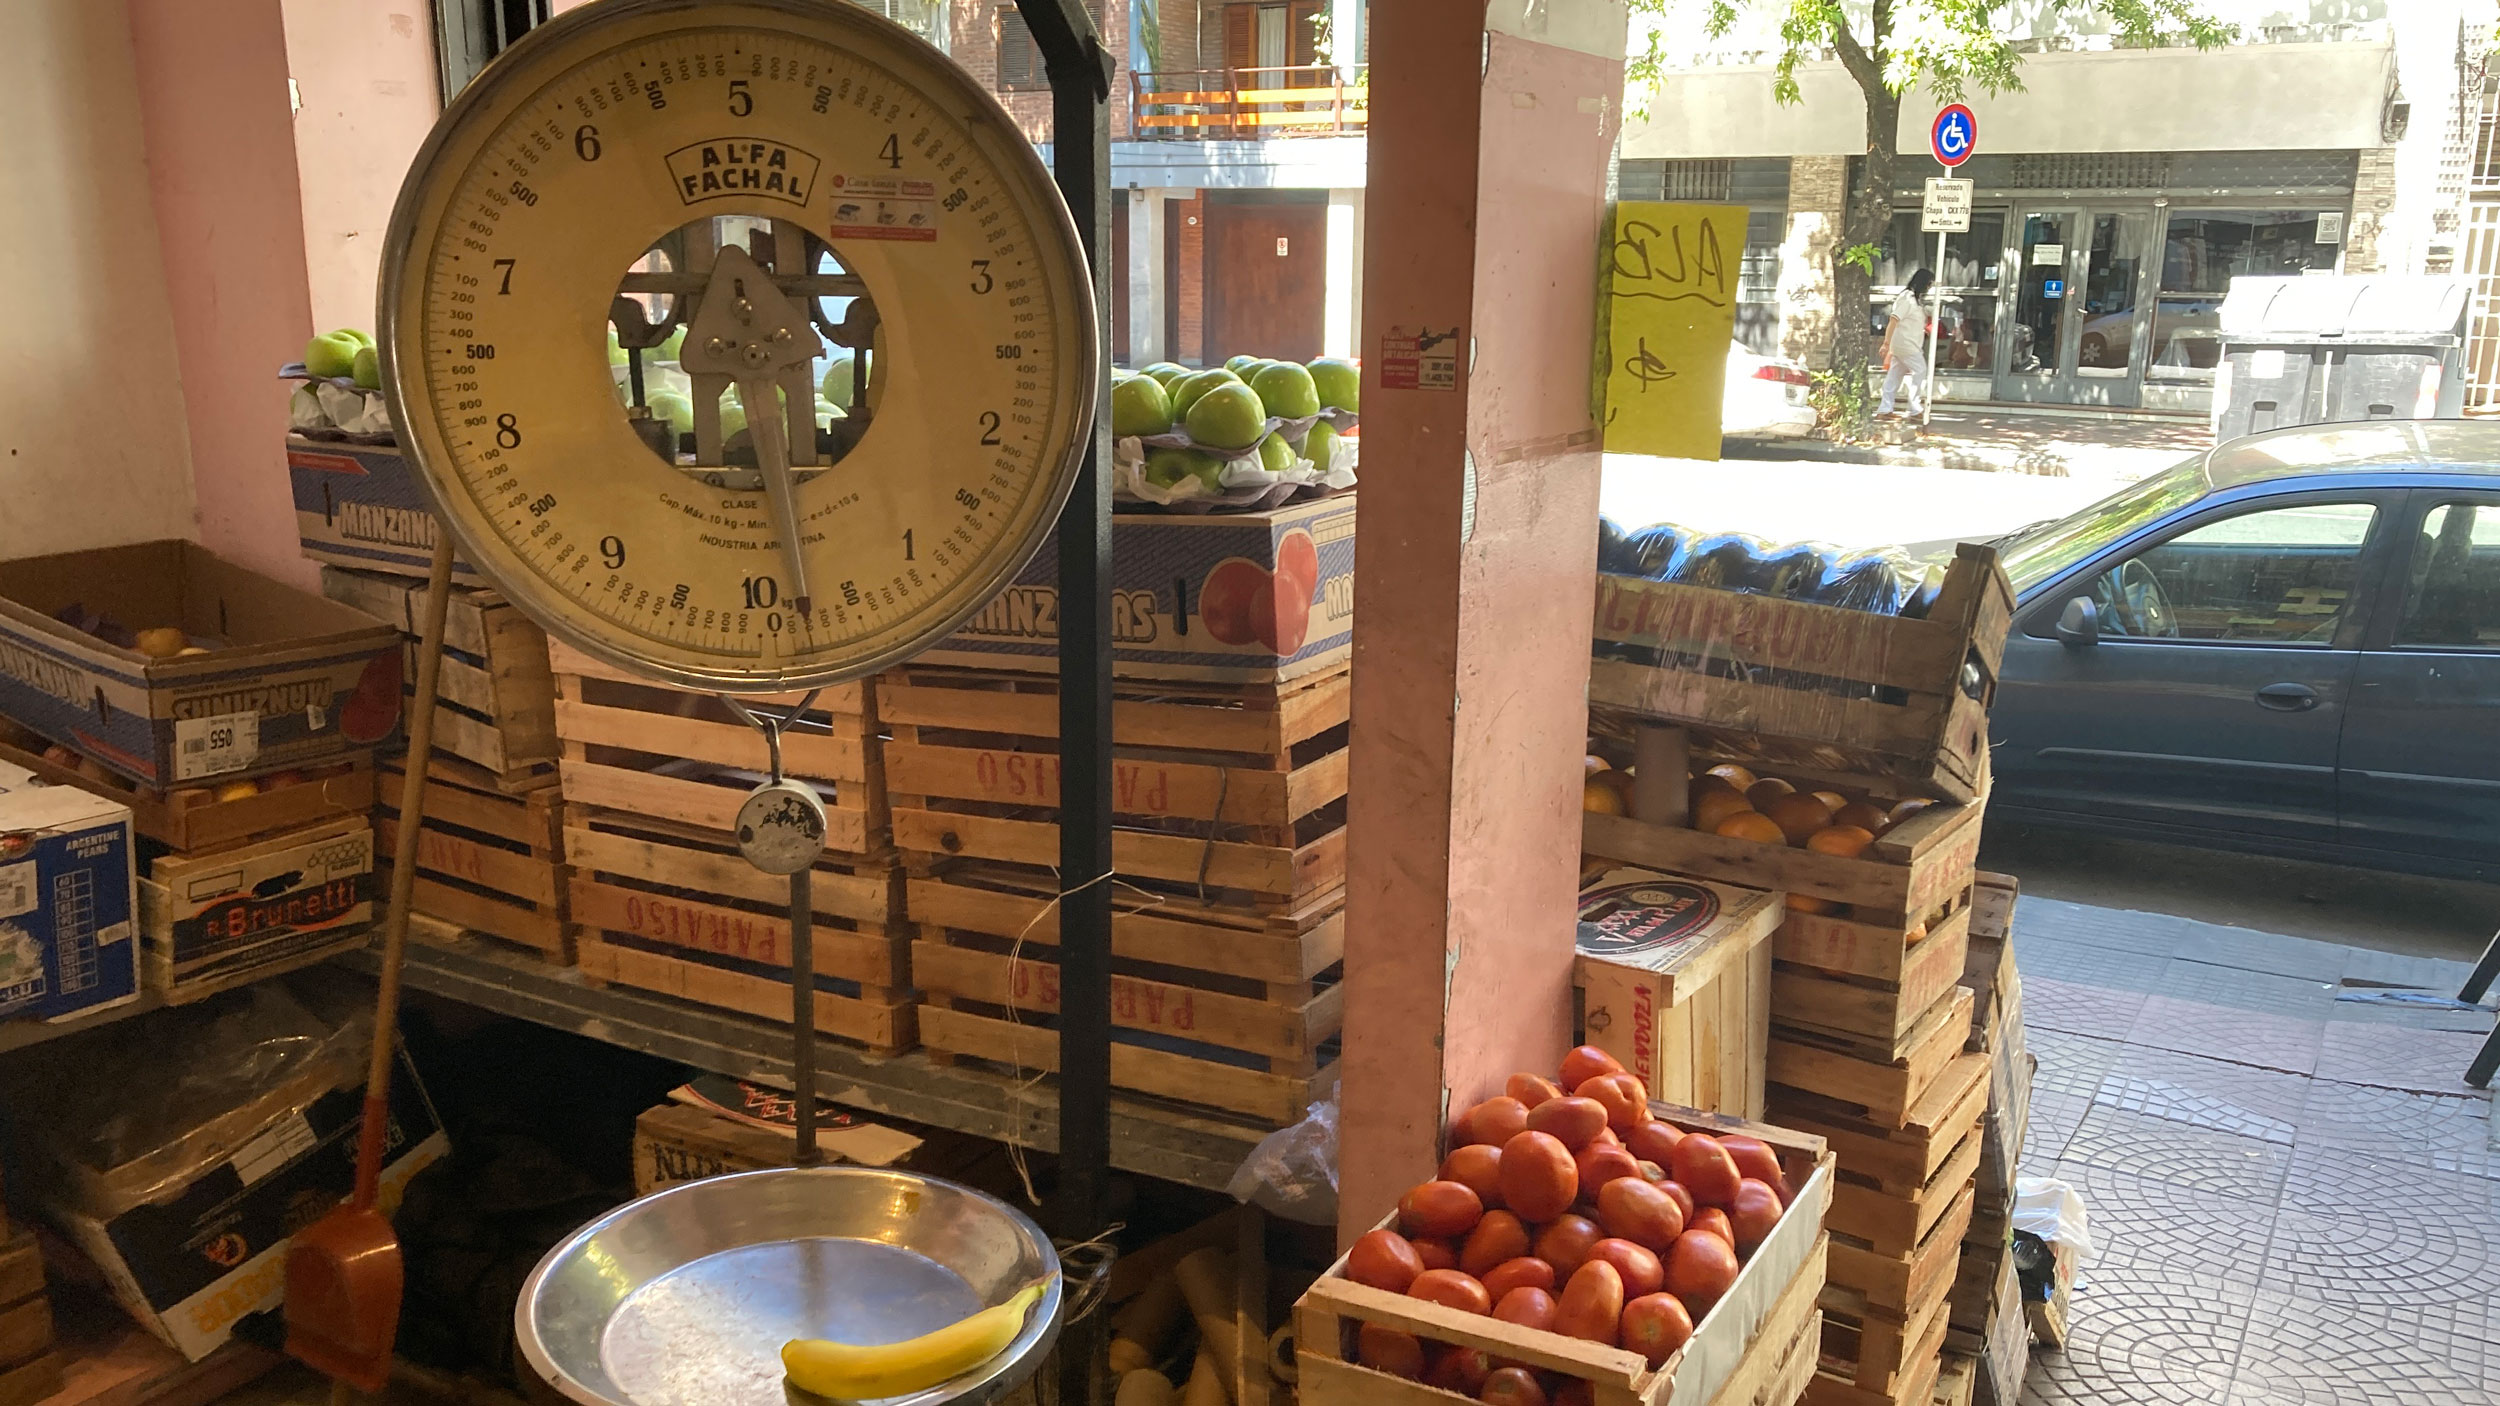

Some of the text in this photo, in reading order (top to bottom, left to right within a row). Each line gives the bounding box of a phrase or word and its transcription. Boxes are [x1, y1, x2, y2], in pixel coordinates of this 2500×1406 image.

[660, 61, 673, 84] 400
[678, 57, 690, 81] 300
[696, 54, 707, 78] 200
[714, 54, 724, 76] 100
[752, 54, 762, 76] 900
[770, 57, 780, 80] 800
[787, 60, 798, 82] 700
[624, 72, 639, 95] 600
[804, 65, 817, 87] 600
[608, 79, 624, 102] 700
[644, 80, 666, 110] 500
[838, 78, 851, 100] 400
[855, 86, 868, 108] 300
[575, 96, 593, 118] 900
[590, 88, 607, 110] 800
[729, 81, 753, 117] 5
[813, 85, 832, 113] 500
[869, 95, 884, 117] 200
[884, 104, 899, 124] 100
[546, 120, 564, 140] 100
[912, 127, 929, 147] 900
[530, 131, 552, 151] 200
[575, 125, 601, 161] 6
[879, 133, 903, 168] 4
[925, 140, 943, 159] 800
[518, 144, 539, 164] 300
[937, 152, 955, 171] 700
[506, 158, 528, 177] 400
[949, 167, 968, 184] 600
[682, 168, 803, 198] FACHAL
[486, 188, 508, 206] 600
[510, 181, 538, 206] 500
[942, 188, 968, 212] 500
[478, 204, 500, 221] 700
[970, 196, 989, 212] 400
[1926, 206, 1942, 215] Chapa
[469, 220, 493, 236] 800
[979, 212, 999, 227] 300
[464, 238, 486, 252] 900
[987, 228, 1006, 243] 200
[994, 244, 1014, 257] 100
[456, 274, 478, 287] 100
[493, 259, 516, 295] 7
[971, 260, 993, 294] 3
[1005, 279, 1025, 290] 900
[451, 292, 474, 304] 200
[1010, 296, 1030, 307] 800
[450, 310, 473, 321] 300
[1014, 313, 1033, 323] 700
[450, 329, 473, 338] 400
[1015, 330, 1035, 339] 600
[467, 344, 495, 359] 500
[996, 345, 1021, 359] 500
[452, 365, 475, 374] 600
[1016, 365, 1037, 373] 400
[456, 382, 478, 392] 700
[1016, 381, 1036, 390] 300
[459, 399, 482, 410] 800
[1013, 397, 1033, 408] 200
[464, 416, 487, 427] 900
[979, 411, 1001, 445] 2
[1012, 413, 1031, 424] 100
[496, 413, 521, 449] 8
[478, 449, 499, 462] 100
[1001, 444, 1021, 458] 900
[486, 464, 508, 479] 200
[995, 459, 1015, 472] 800
[496, 478, 518, 494] 300
[990, 474, 1008, 488] 700
[508, 493, 528, 509] 400
[529, 493, 556, 517] 500
[722, 500, 758, 509] CLASE
[955, 488, 980, 511] 500
[982, 488, 1000, 503] 600
[660, 493, 681, 510] Cap.
[710, 515, 721, 524] 10
[724, 517, 737, 529] kg
[531, 520, 550, 538] 600
[964, 514, 982, 530] 400
[544, 532, 562, 549] 700
[700, 533, 826, 550] INDUSTRIA ARTINA
[902, 528, 915, 560] 1
[954, 526, 972, 544] 300
[556, 544, 575, 562] 800
[600, 536, 625, 569] 9
[943, 538, 961, 556] 200
[571, 555, 589, 574] 900
[933, 549, 949, 566] 100
[604, 574, 619, 593] 100
[893, 577, 909, 596] 800
[906, 568, 922, 587] 900
[619, 582, 634, 603] 200
[634, 590, 649, 610] 300
[670, 584, 690, 610] 500
[741, 576, 778, 609] 10
[841, 581, 860, 606] 500
[864, 592, 878, 611] 600
[880, 586, 894, 605] 700
[652, 596, 665, 616] 400
[835, 604, 847, 624] 400
[686, 606, 698, 626] 600
[704, 610, 714, 629] 700
[721, 612, 731, 632] 800
[738, 614, 748, 634] 900
[767, 612, 782, 631] 0
[786, 614, 796, 634] 100
[818, 608, 830, 628] 300
[210, 728, 232, 750] 055
[66, 830, 120, 851] ARGENTINE
[77, 846, 109, 860] PEARS
[228, 879, 356, 937] Brunetti
[626, 896, 776, 961] PARAISO
